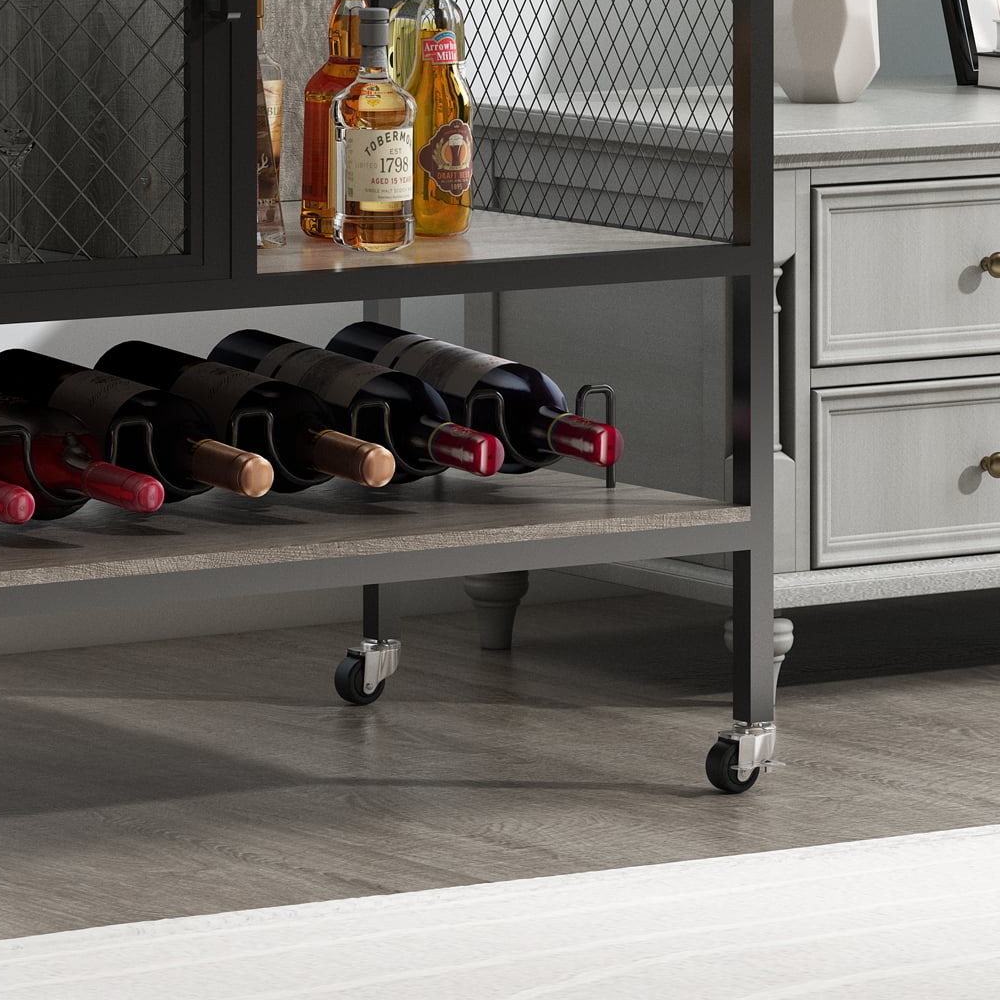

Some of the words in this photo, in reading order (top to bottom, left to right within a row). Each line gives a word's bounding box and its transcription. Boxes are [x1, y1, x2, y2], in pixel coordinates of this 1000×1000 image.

[380, 156, 409, 174] 1798
[371, 177, 389, 185] AGED
[391, 177, 398, 185] 15
